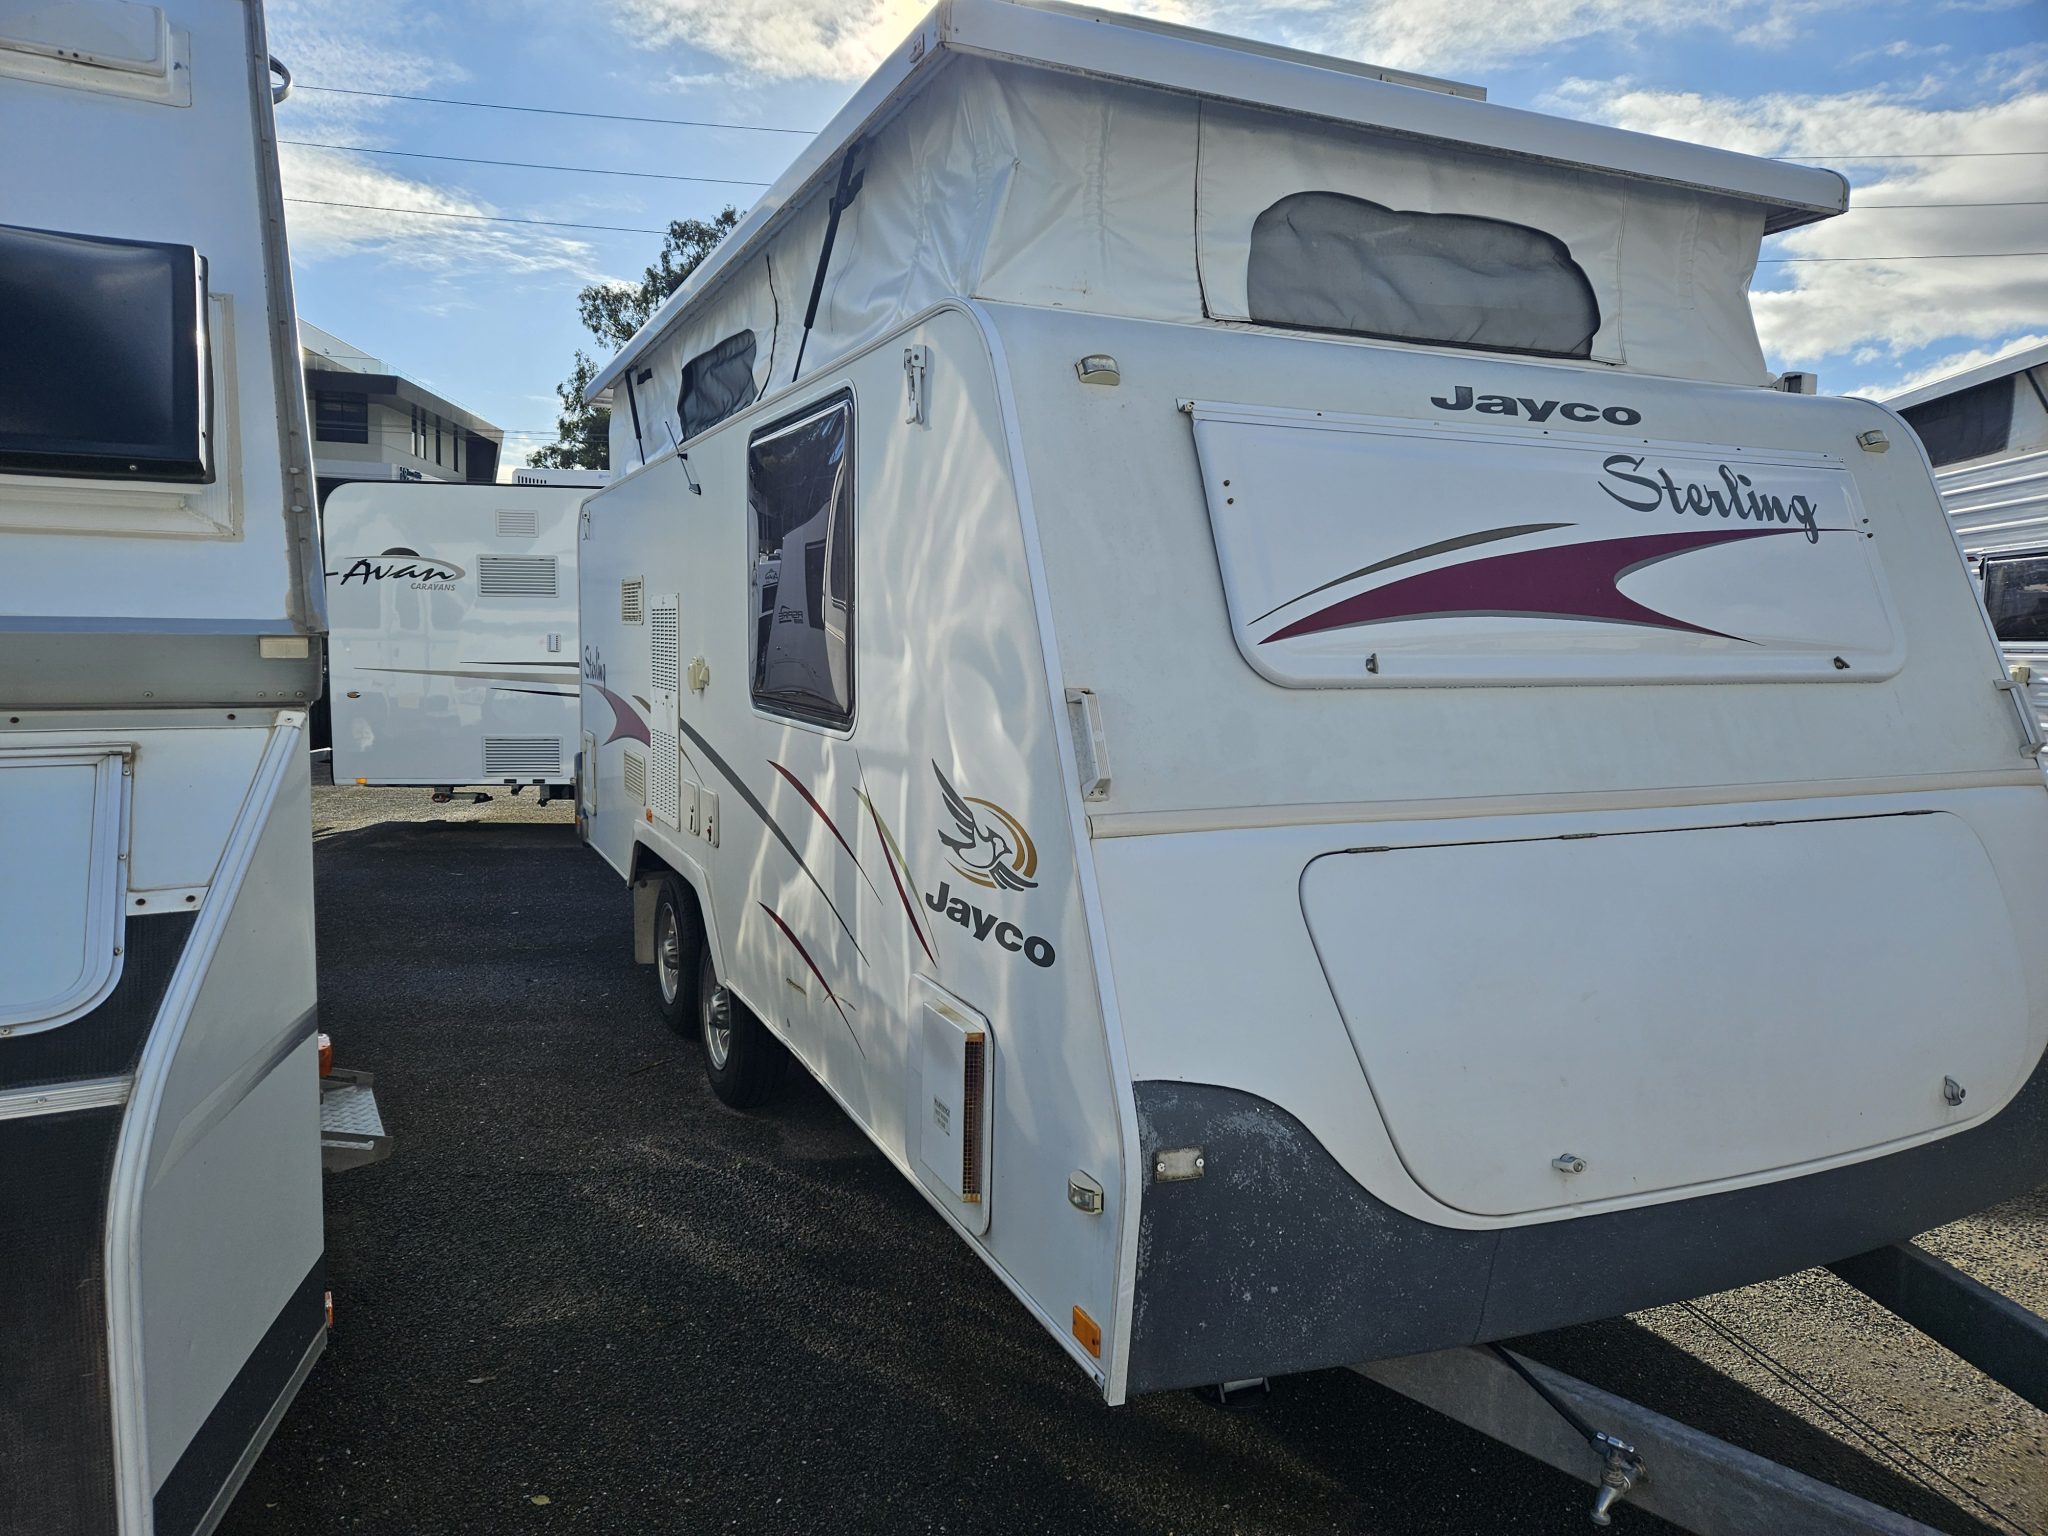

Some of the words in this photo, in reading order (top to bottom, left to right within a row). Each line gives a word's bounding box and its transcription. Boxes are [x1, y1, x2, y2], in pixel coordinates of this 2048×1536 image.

[1430, 385, 1642, 426] Jayco
[1597, 454, 1818, 544] Sterling
[340, 558, 455, 586] Avan
[410, 582, 456, 592] CARAVANS
[925, 881, 1056, 968] Jayco
